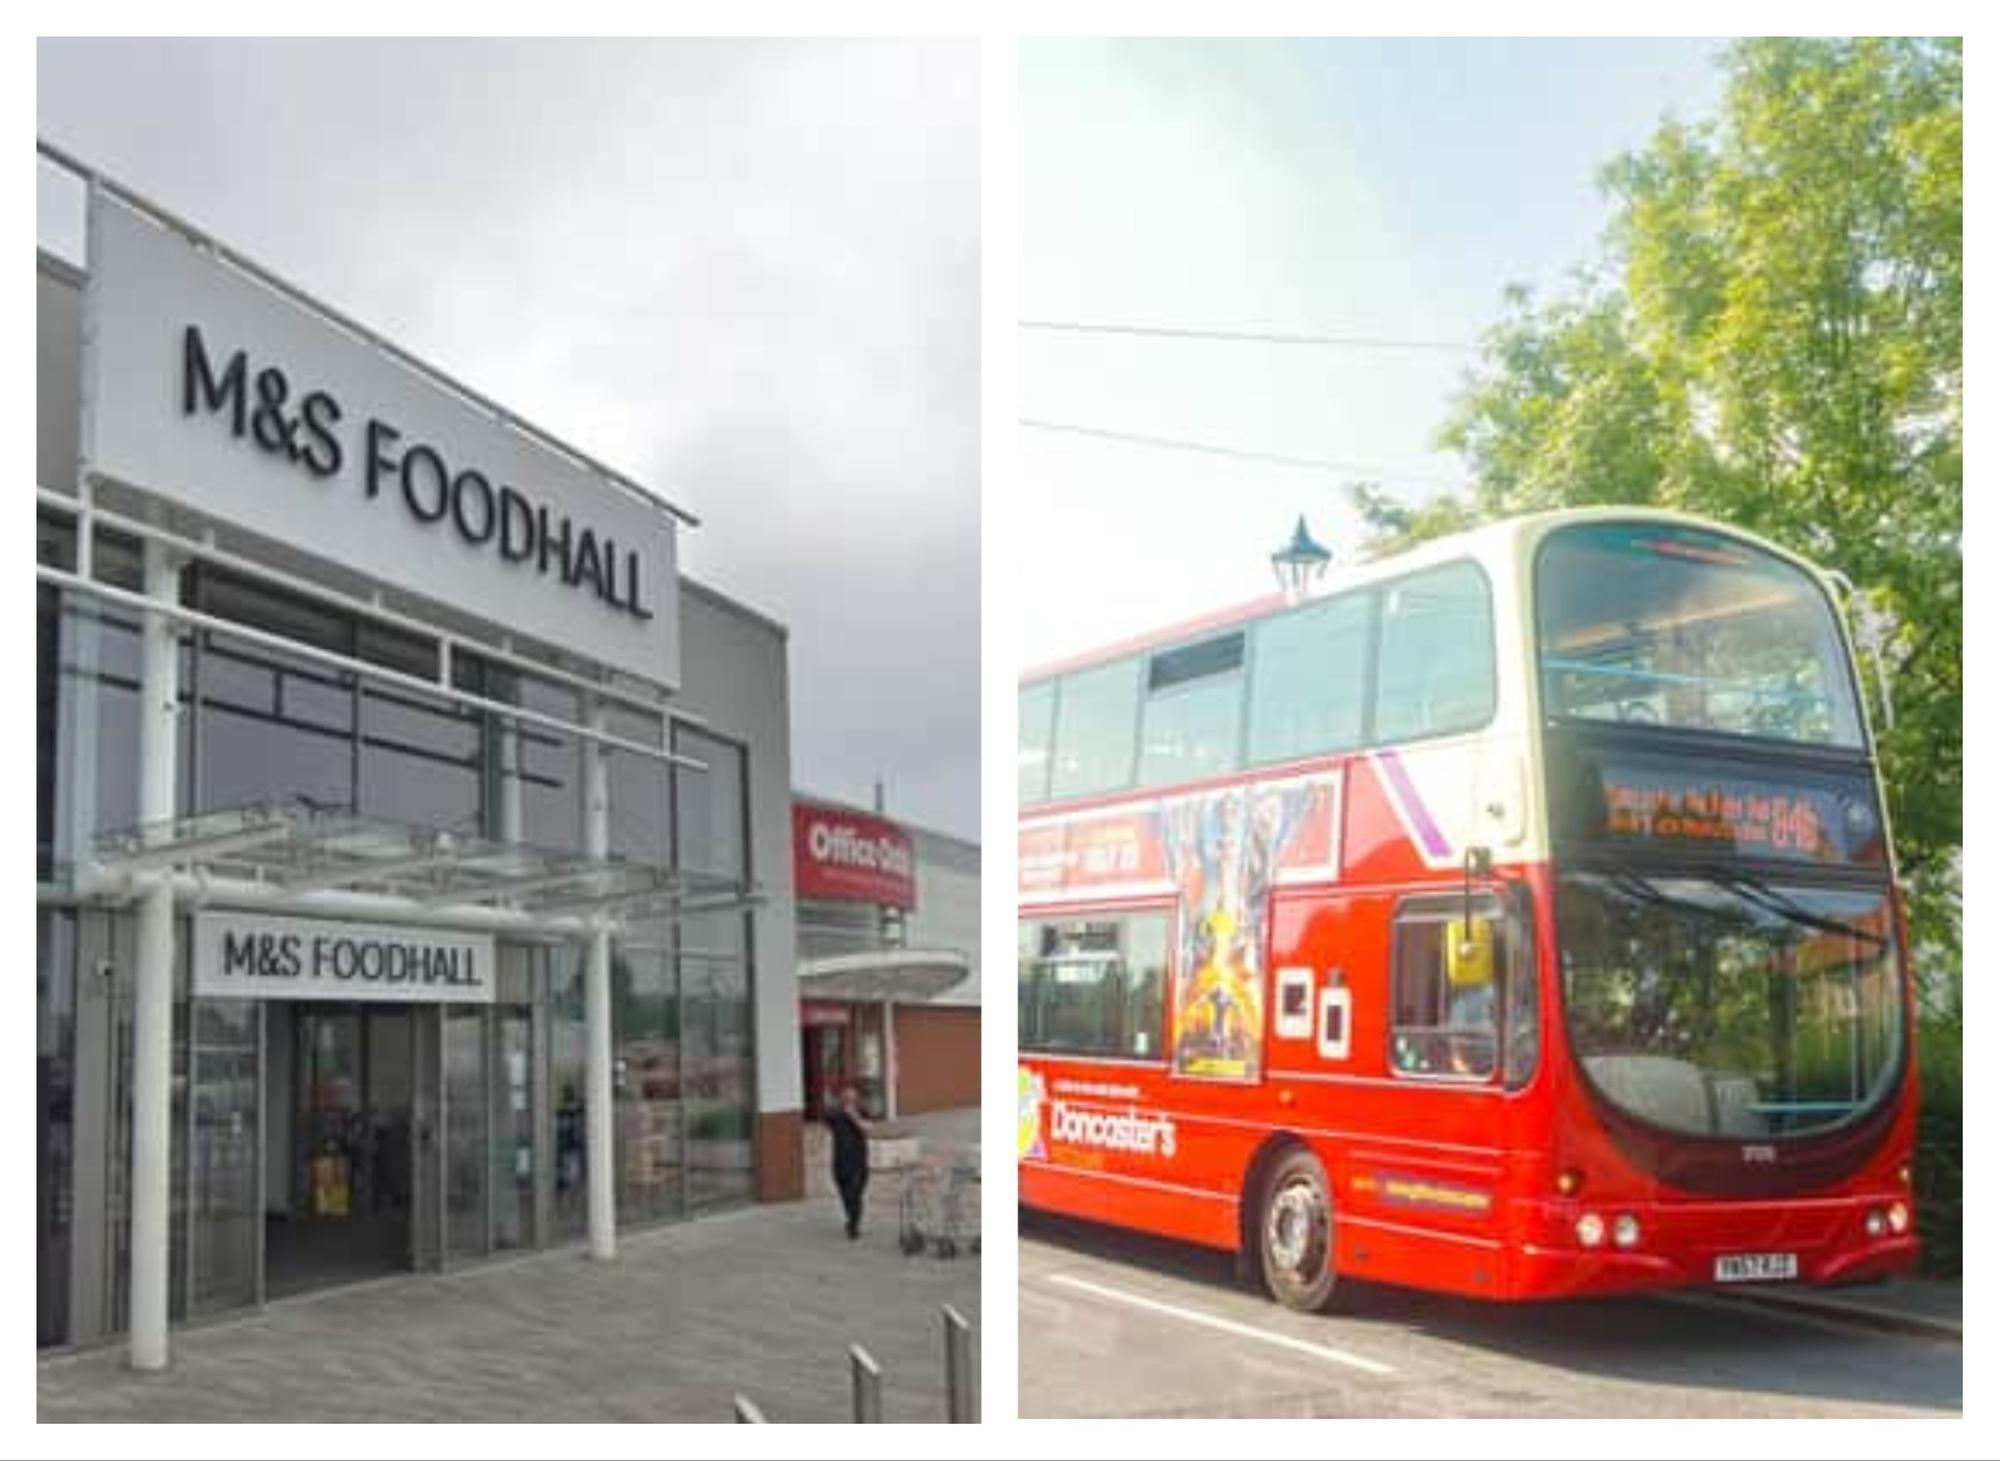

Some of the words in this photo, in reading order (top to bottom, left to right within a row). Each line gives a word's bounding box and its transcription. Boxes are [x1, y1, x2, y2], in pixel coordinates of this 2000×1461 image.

[182, 324, 344, 478] M&S
[364, 418, 654, 620] FOODHALL
[809, 822, 877, 867] Office
[223, 930, 301, 978] M&S
[311, 935, 483, 987] FOODHALL
[1051, 1100, 1177, 1159] Doncaster's
